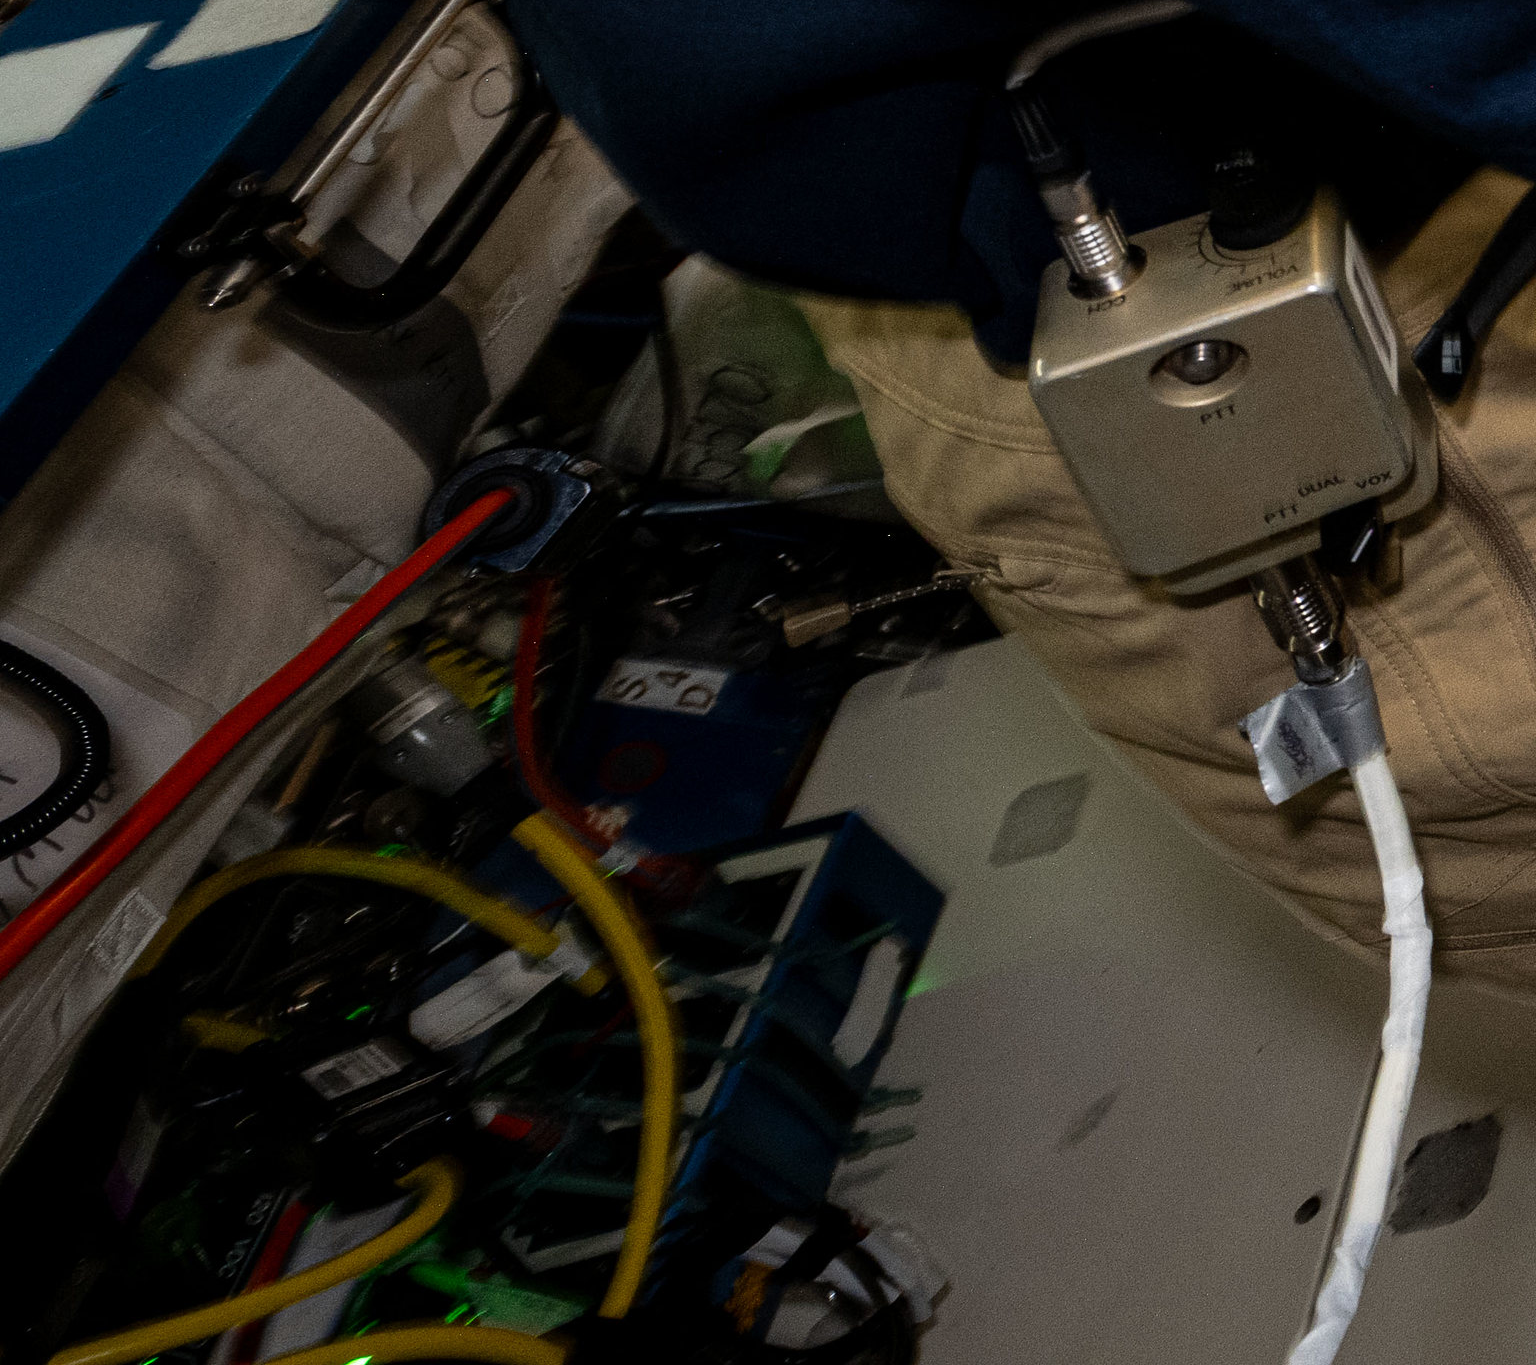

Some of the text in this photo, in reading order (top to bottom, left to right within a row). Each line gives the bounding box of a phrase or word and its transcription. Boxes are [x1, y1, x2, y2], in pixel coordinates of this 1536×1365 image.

[1086, 293, 1128, 317] CCH
[1200, 403, 1238, 427] PTT
[1296, 475, 1345, 499] DUAL
[1353, 470, 1394, 491] VOX
[1263, 503, 1302, 526] PTT
